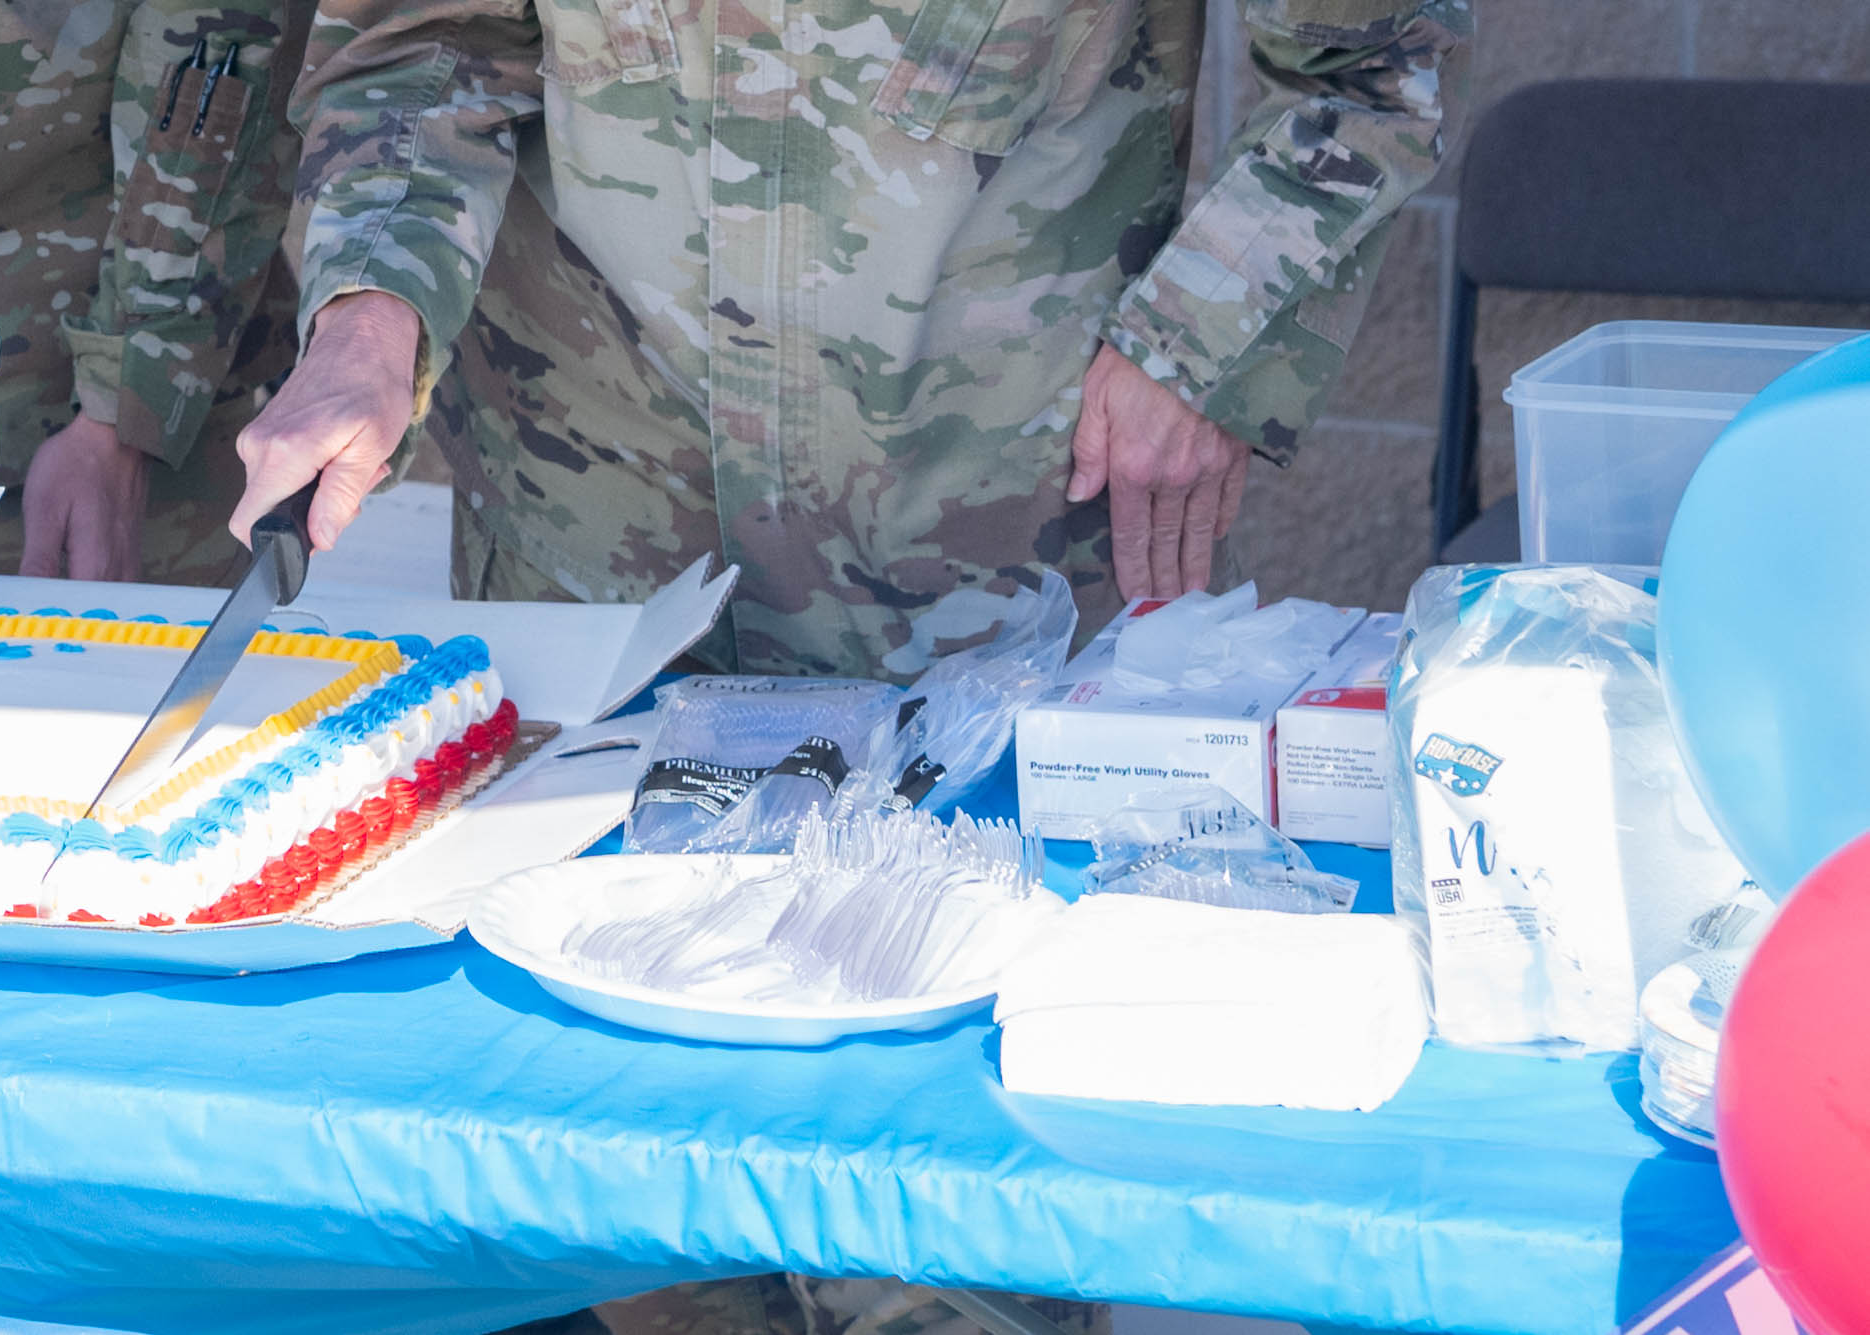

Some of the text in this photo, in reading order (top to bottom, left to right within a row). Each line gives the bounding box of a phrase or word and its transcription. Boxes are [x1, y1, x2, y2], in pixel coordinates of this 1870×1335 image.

[1204, 733, 1249, 747] 1201713
[665, 758, 758, 782] PREMIUM
[1030, 761, 1210, 780] Powder-Free Vinyl Utility Gloves
[1437, 891, 1462, 904] USA
